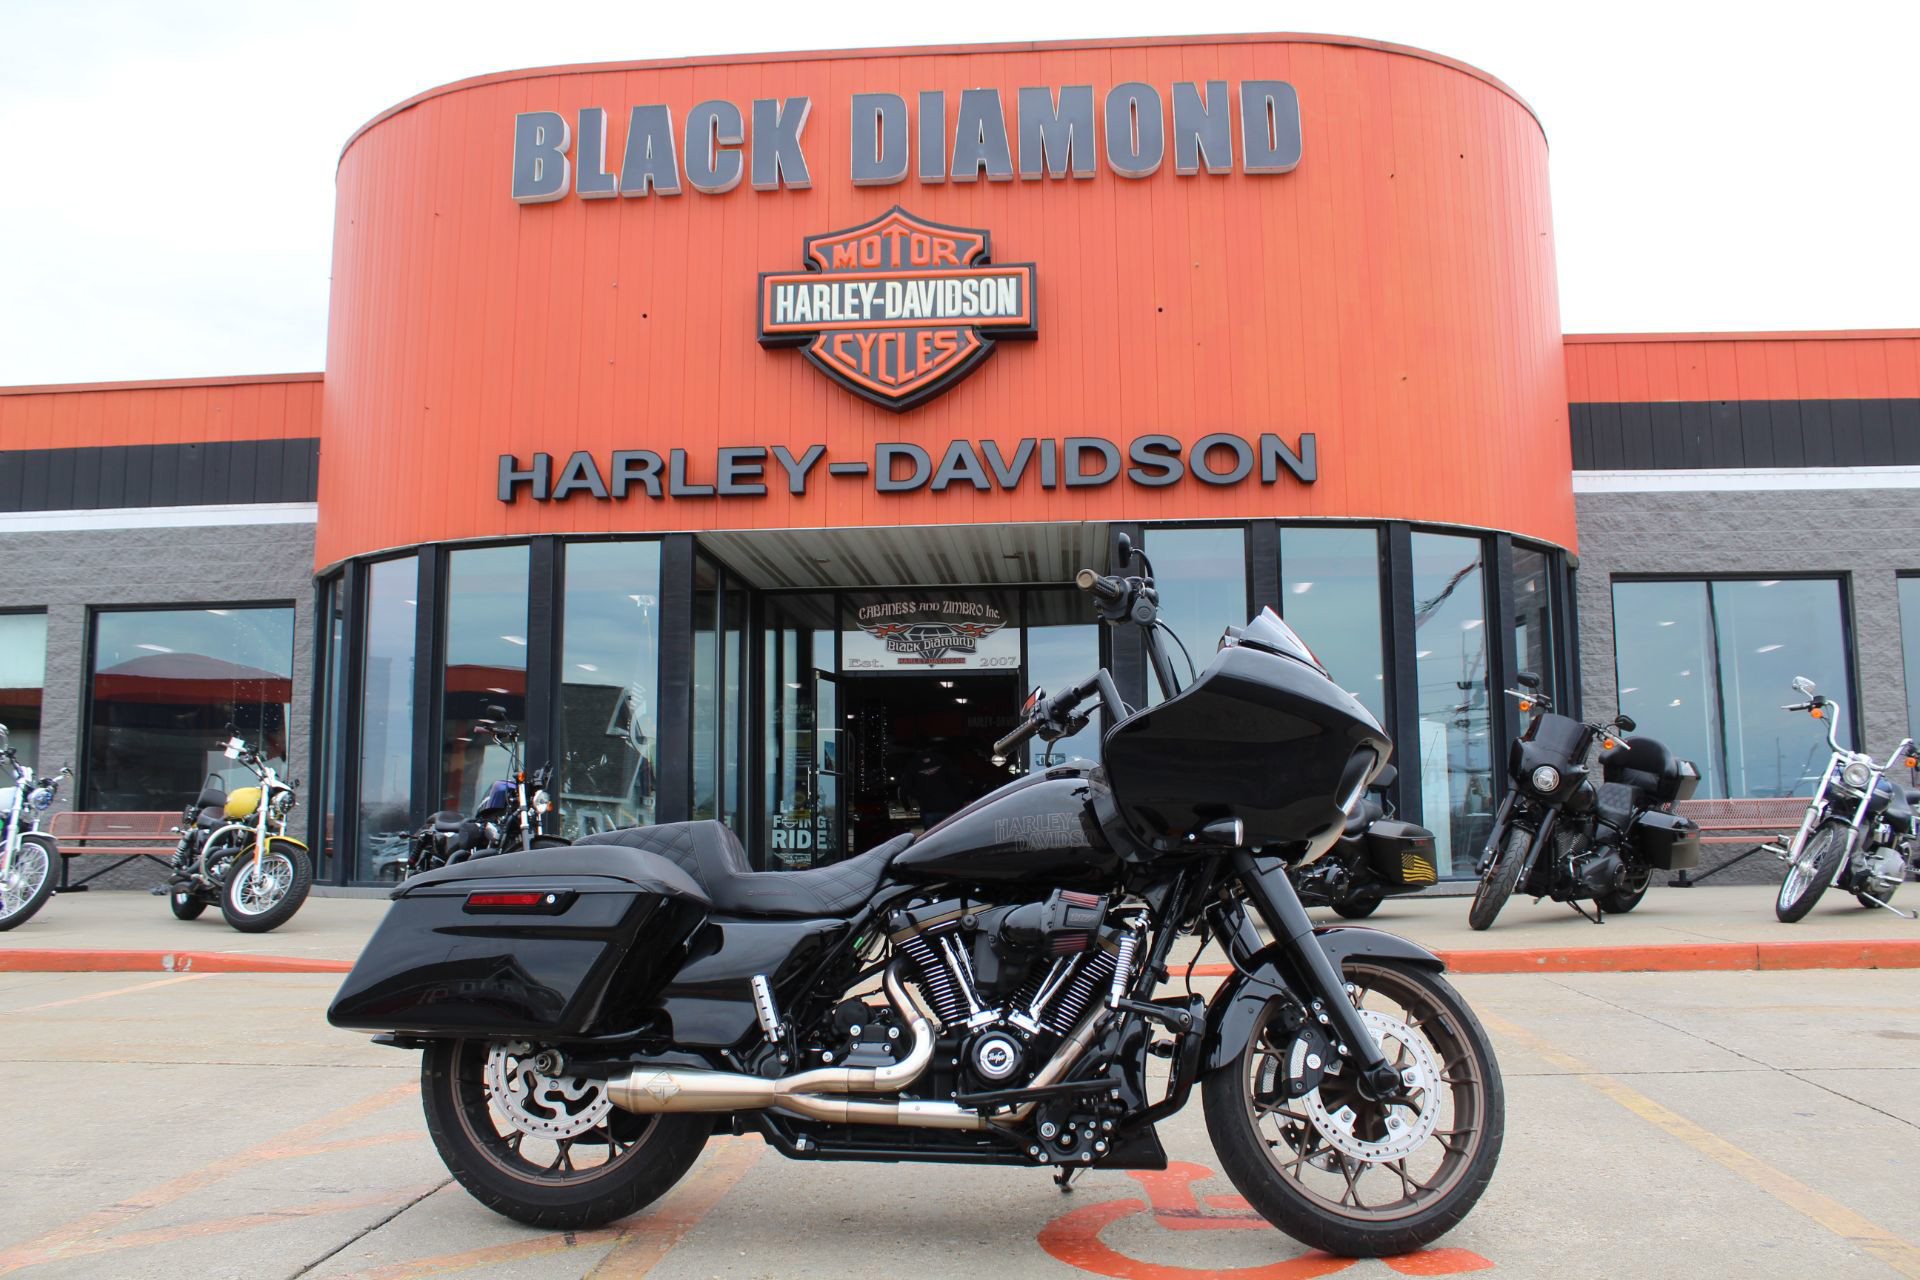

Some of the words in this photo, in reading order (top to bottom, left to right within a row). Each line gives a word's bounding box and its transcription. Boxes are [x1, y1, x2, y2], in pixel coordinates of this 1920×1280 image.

[511, 95, 813, 206] BLACK
[850, 79, 1303, 189] DIAMOND
[832, 229, 960, 270] MOTOR
[776, 277, 1017, 324] HARLEY-DAVIDSON
[833, 330, 960, 387] CYCLES
[497, 432, 1317, 503] HARLEY-DAVIDSON
[942, 600, 984, 616] ZIMBRO
[985, 605, 1001, 619] Inc.
[848, 658, 884, 668] Est.
[980, 656, 1016, 668] 2007
[771, 829, 828, 849] RIDE
